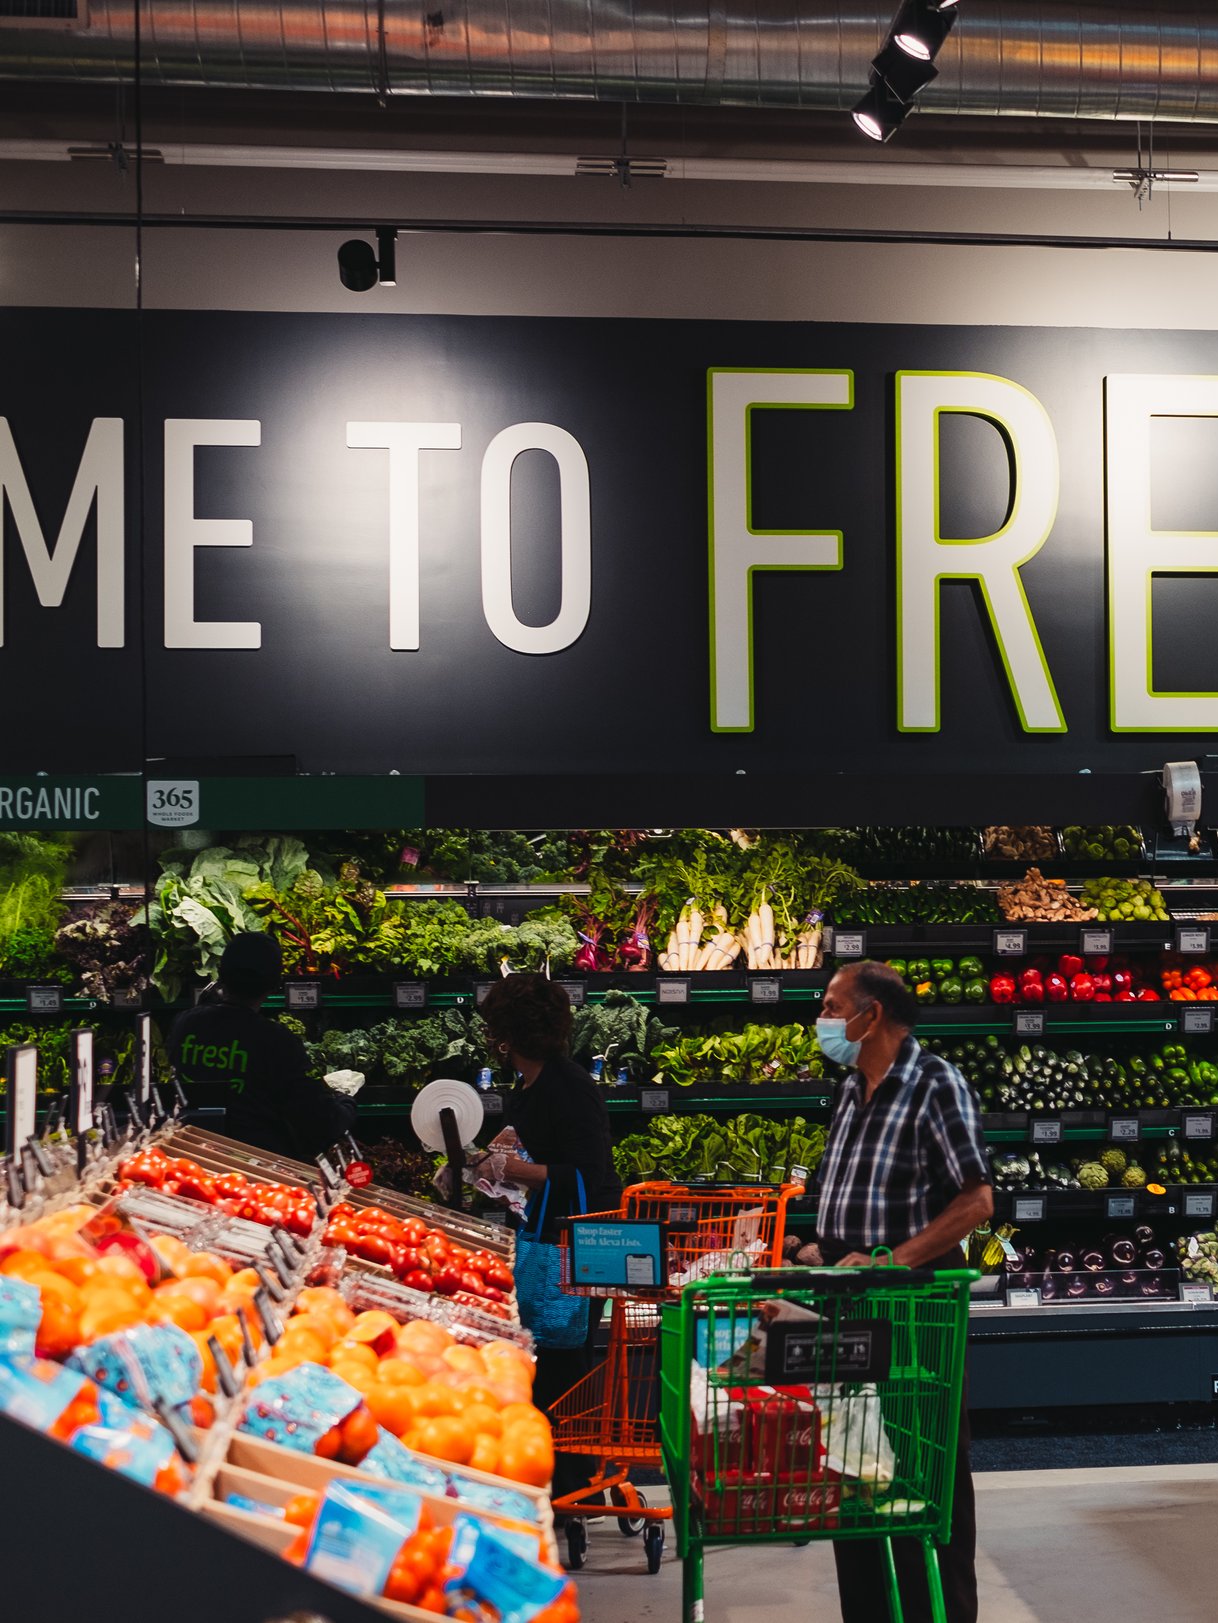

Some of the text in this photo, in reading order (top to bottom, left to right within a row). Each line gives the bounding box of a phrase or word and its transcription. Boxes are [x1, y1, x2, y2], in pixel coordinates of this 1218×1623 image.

[0, 416, 261, 648] ME
[346, 421, 591, 654] TO
[0, 787, 100, 819] RGANIC
[152, 787, 193, 809] 365
[181, 1034, 248, 1072] fresh
[577, 1227, 623, 1237] Shop faster
[578, 1237, 597, 1246] with
[599, 1237, 620, 1246] Alexa
[783, 1484, 834, 1507] CocaCola
